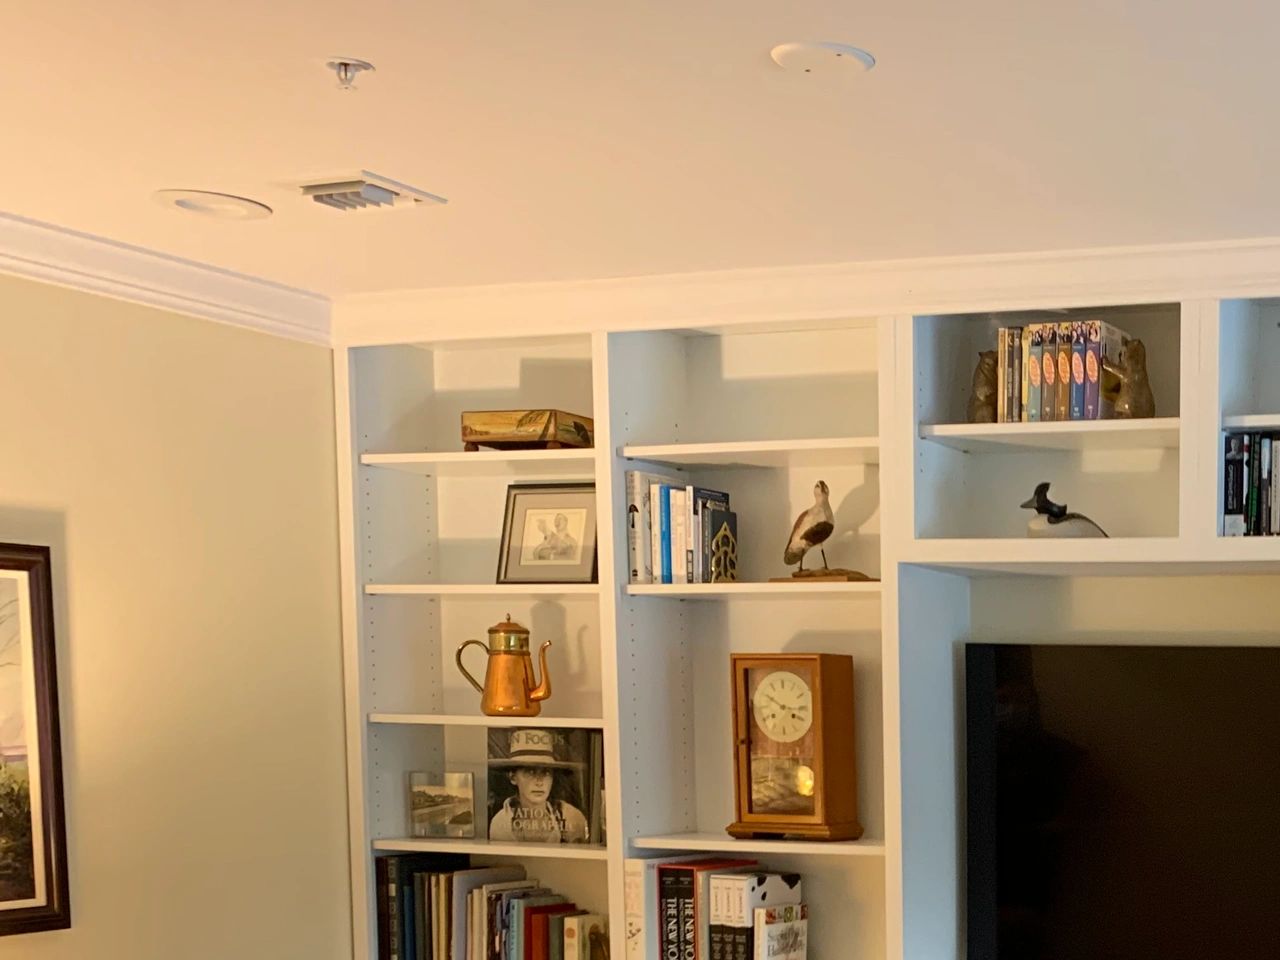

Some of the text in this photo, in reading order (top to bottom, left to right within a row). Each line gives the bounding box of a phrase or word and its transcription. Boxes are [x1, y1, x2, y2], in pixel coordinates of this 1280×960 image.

[667, 897, 677, 916] THE
[685, 897, 694, 916] THE
[667, 918, 678, 942] NEW
[685, 918, 695, 942] NEW
